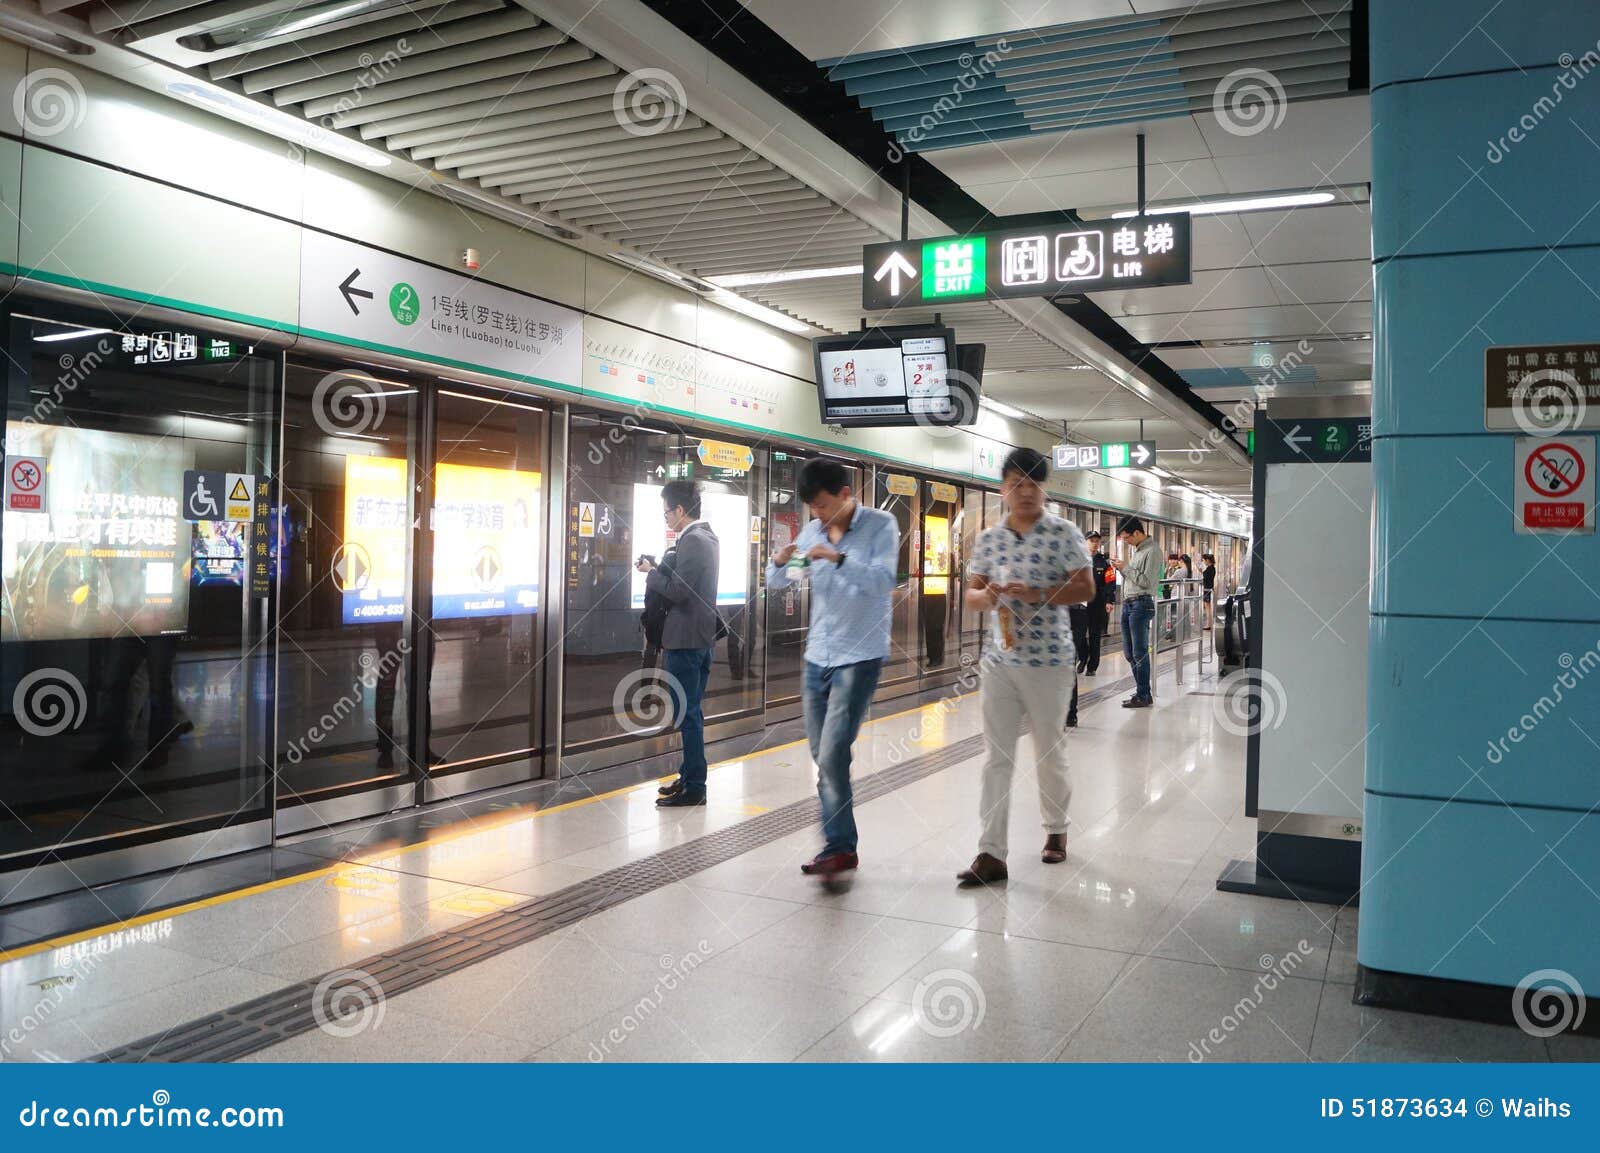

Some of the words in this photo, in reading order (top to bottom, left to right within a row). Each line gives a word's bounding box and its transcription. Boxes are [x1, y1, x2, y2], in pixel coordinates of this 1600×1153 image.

[1112, 223, 1174, 256] 电梯
[1113, 261, 1142, 278] Lift
[935, 276, 971, 292] EXIT
[399, 286, 412, 311] 2
[397, 311, 413, 323] 站台
[431, 319, 453, 334] Line
[455, 326, 460, 335] 1
[462, 326, 503, 349] (Luobao)
[504, 337, 514, 349] to
[515, 341, 542, 355] Luohu
[913, 373, 922, 385] 2
[1326, 426, 1338, 443] 2
[256, 482, 269, 577] 请排队候车
